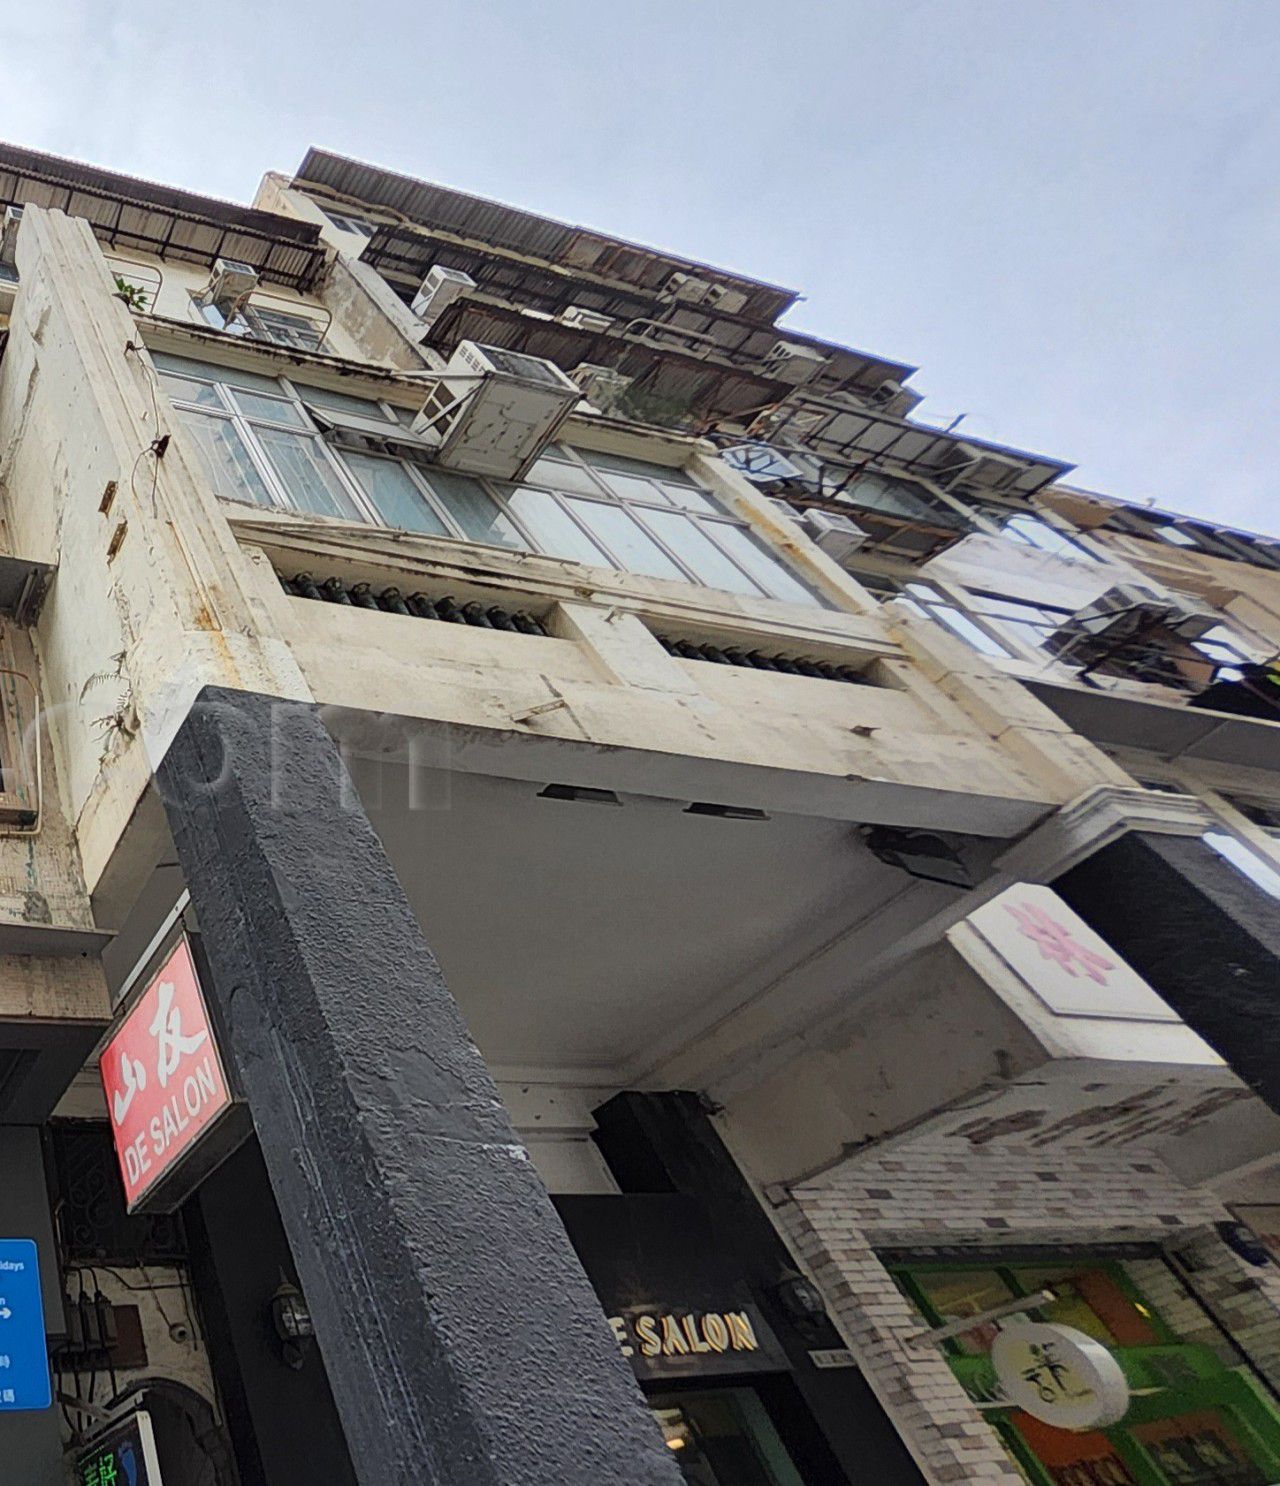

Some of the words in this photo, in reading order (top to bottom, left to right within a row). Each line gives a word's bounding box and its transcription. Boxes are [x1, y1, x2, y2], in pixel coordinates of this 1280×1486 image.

[124, 1131, 152, 1186] DE
[150, 1057, 217, 1156] SALON
[634, 1310, 759, 1357] SALON
